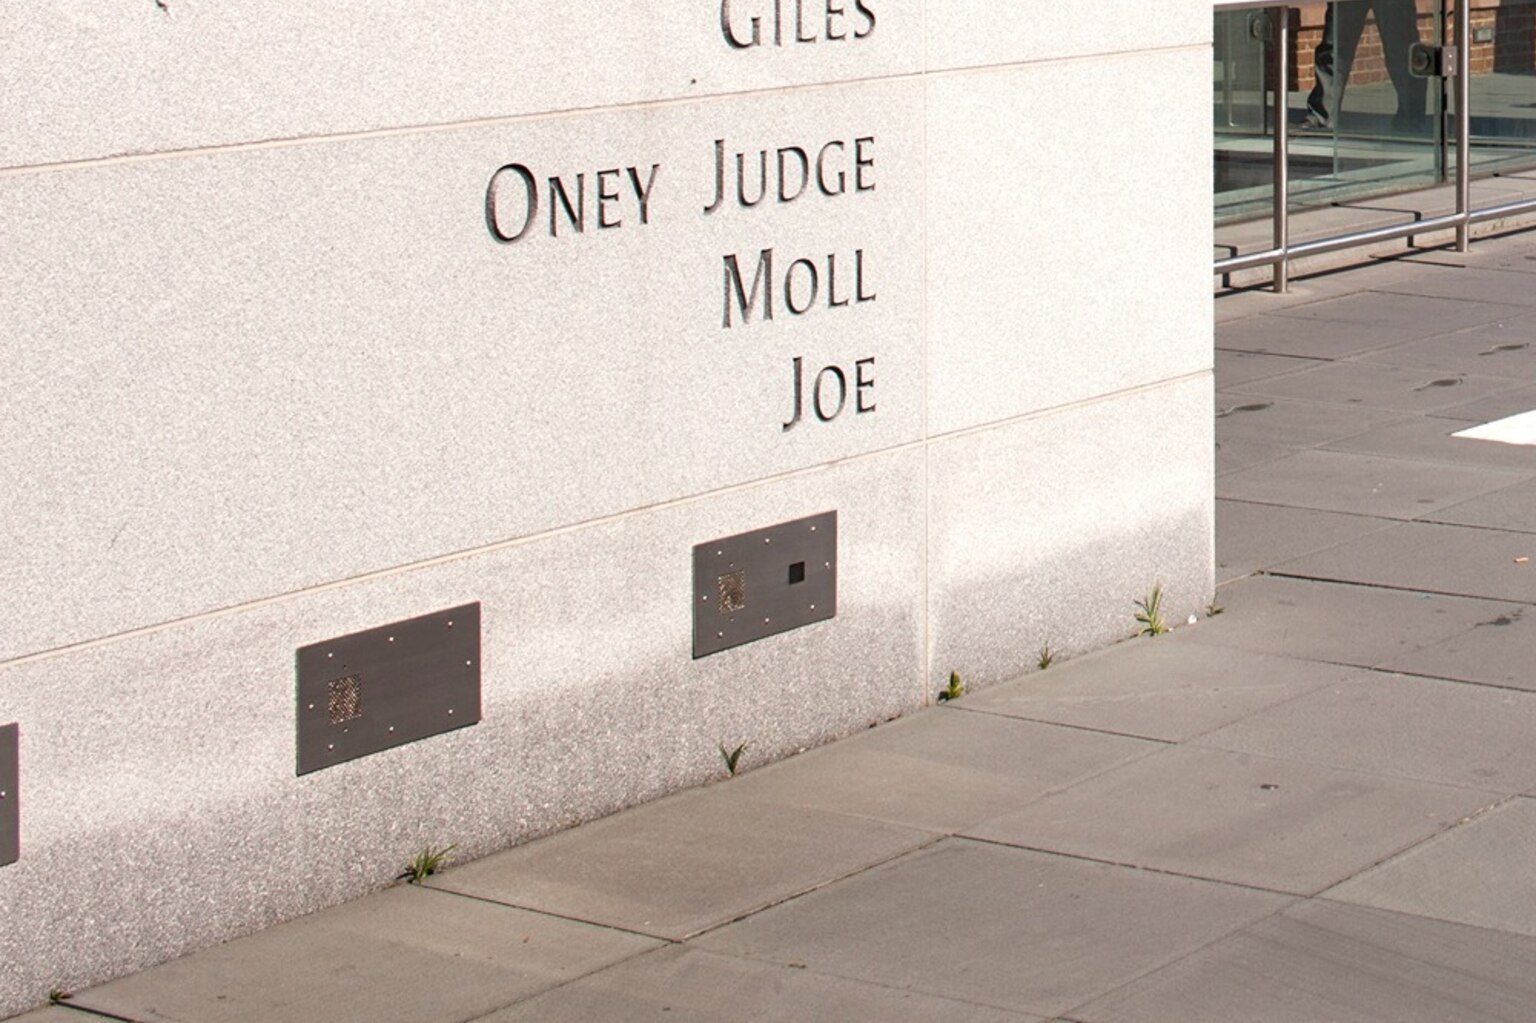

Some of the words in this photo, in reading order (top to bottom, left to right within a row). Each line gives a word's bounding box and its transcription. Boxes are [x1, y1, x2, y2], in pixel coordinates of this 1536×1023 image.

[484, 162, 661, 246] ONEY
[703, 136, 877, 216] JUDGE
[721, 248, 877, 329] MOLL
[782, 356, 877, 433] JOE
